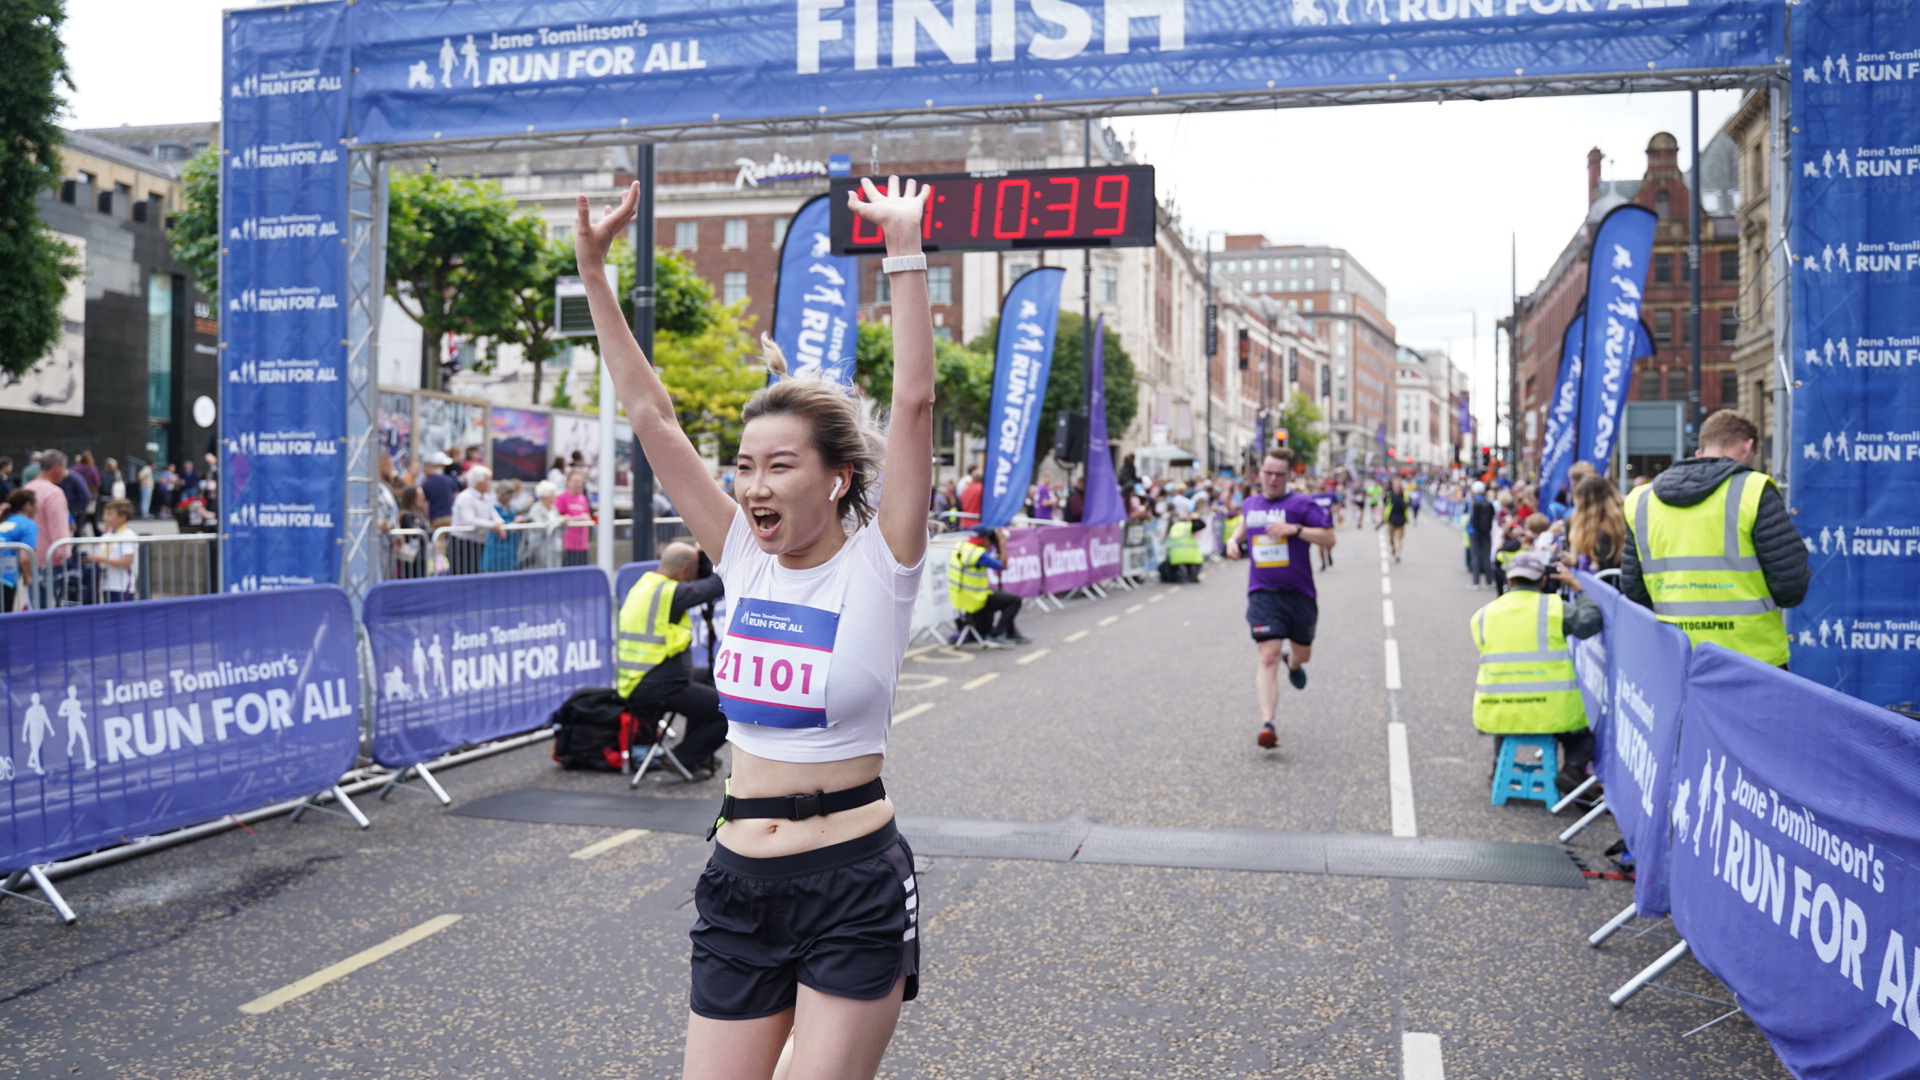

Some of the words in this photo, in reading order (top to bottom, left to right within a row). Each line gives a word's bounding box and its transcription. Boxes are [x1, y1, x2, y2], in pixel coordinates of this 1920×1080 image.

[489, 32, 535, 51] Jane
[537, 18, 648, 46] Tomlinson's
[797, 0, 1185, 74] FINISH
[486, 52, 560, 86] RUN
[567, 45, 635, 79] FOR
[643, 39, 707, 73] ALL
[1856, 52, 1885, 63] Jane
[1855, 63, 1902, 82] RUN
[259, 81, 289, 96] RUN
[291, 78, 315, 93] FOR
[318, 76, 342, 91] ALL
[258, 153, 289, 168] RUN
[290, 150, 316, 166] FOR
[320, 149, 338, 164] ALL
[1856, 147, 1885, 158] Jane
[1855, 159, 1902, 177] RUN
[258, 225, 288, 240] RUN
[290, 223, 316, 238] FOR
[319, 222, 338, 236] ALL
[1856, 242, 1884, 252] Jane
[1855, 255, 1901, 272] RUN
[258, 297, 288, 312] RUN
[289, 295, 315, 310] FOR
[318, 294, 338, 309] ALL
[793, 307, 830, 379] RUN
[1856, 337, 1884, 347] Jane
[1855, 349, 1901, 367] RUN
[258, 369, 287, 384] RUN
[288, 368, 315, 383] FOR
[316, 367, 338, 382] ALL
[1005, 352, 1031, 406] RUN
[999, 405, 1023, 455] FOR
[1855, 431, 1884, 442] Jane
[258, 441, 287, 455] RUN
[287, 440, 313, 455] FOR
[313, 440, 337, 454] ALL
[1854, 444, 1900, 462] RUN
[993, 455, 1013, 499] ALL
[258, 513, 286, 528] RUN
[287, 512, 311, 527] FOR
[312, 512, 334, 527] ALL
[1853, 526, 1883, 537] Jane
[1852, 538, 1900, 556] RUN
[749, 617, 768, 628] RUN
[768, 620, 787, 630] FOR
[787, 624, 804, 633] ALL
[1852, 619, 1881, 630] Jane
[451, 630, 488, 651] Jane
[490, 618, 566, 645] Tomlinson's
[1851, 633, 1898, 650] RUN
[452, 652, 508, 694] RUN
[512, 644, 559, 683] FOR
[563, 638, 602, 673] ALL
[716, 649, 813, 695] 21101
[102, 678, 164, 706] Jane
[169, 653, 299, 694] Tomlinson's
[103, 702, 204, 763] RUN
[212, 688, 294, 741] FOR
[302, 678, 352, 724] ALL
[1731, 766, 1767, 819] Jane
[1769, 788, 1885, 893] Tomlinson's
[1723, 819, 1785, 926] RUN
[1790, 865, 1867, 991] FOR
